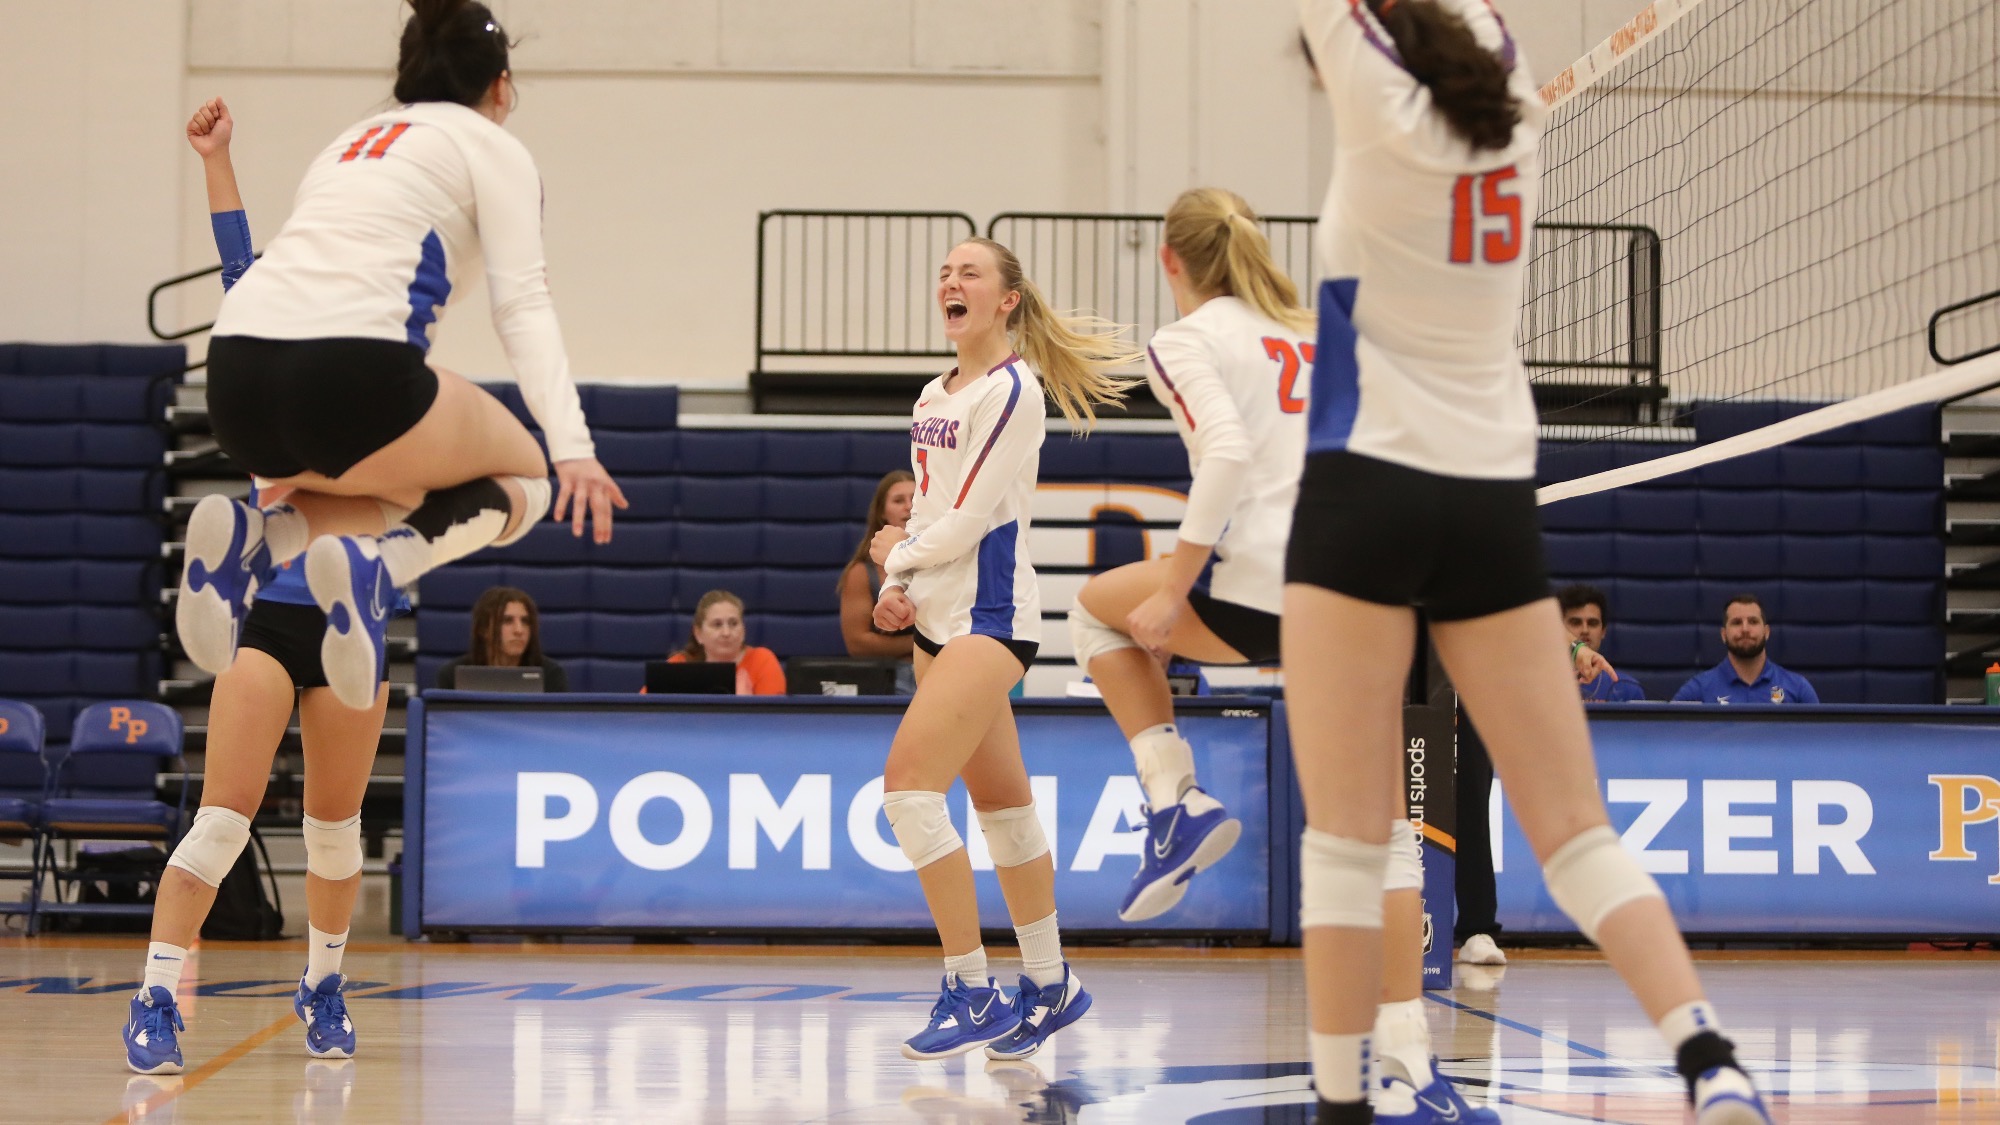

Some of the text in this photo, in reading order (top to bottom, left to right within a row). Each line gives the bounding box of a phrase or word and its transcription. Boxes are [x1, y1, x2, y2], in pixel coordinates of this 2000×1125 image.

[337, 122, 412, 164] 11
[1448, 164, 1523, 264] 15
[916, 447, 930, 497] 7
[1407, 737, 1428, 801] sports
